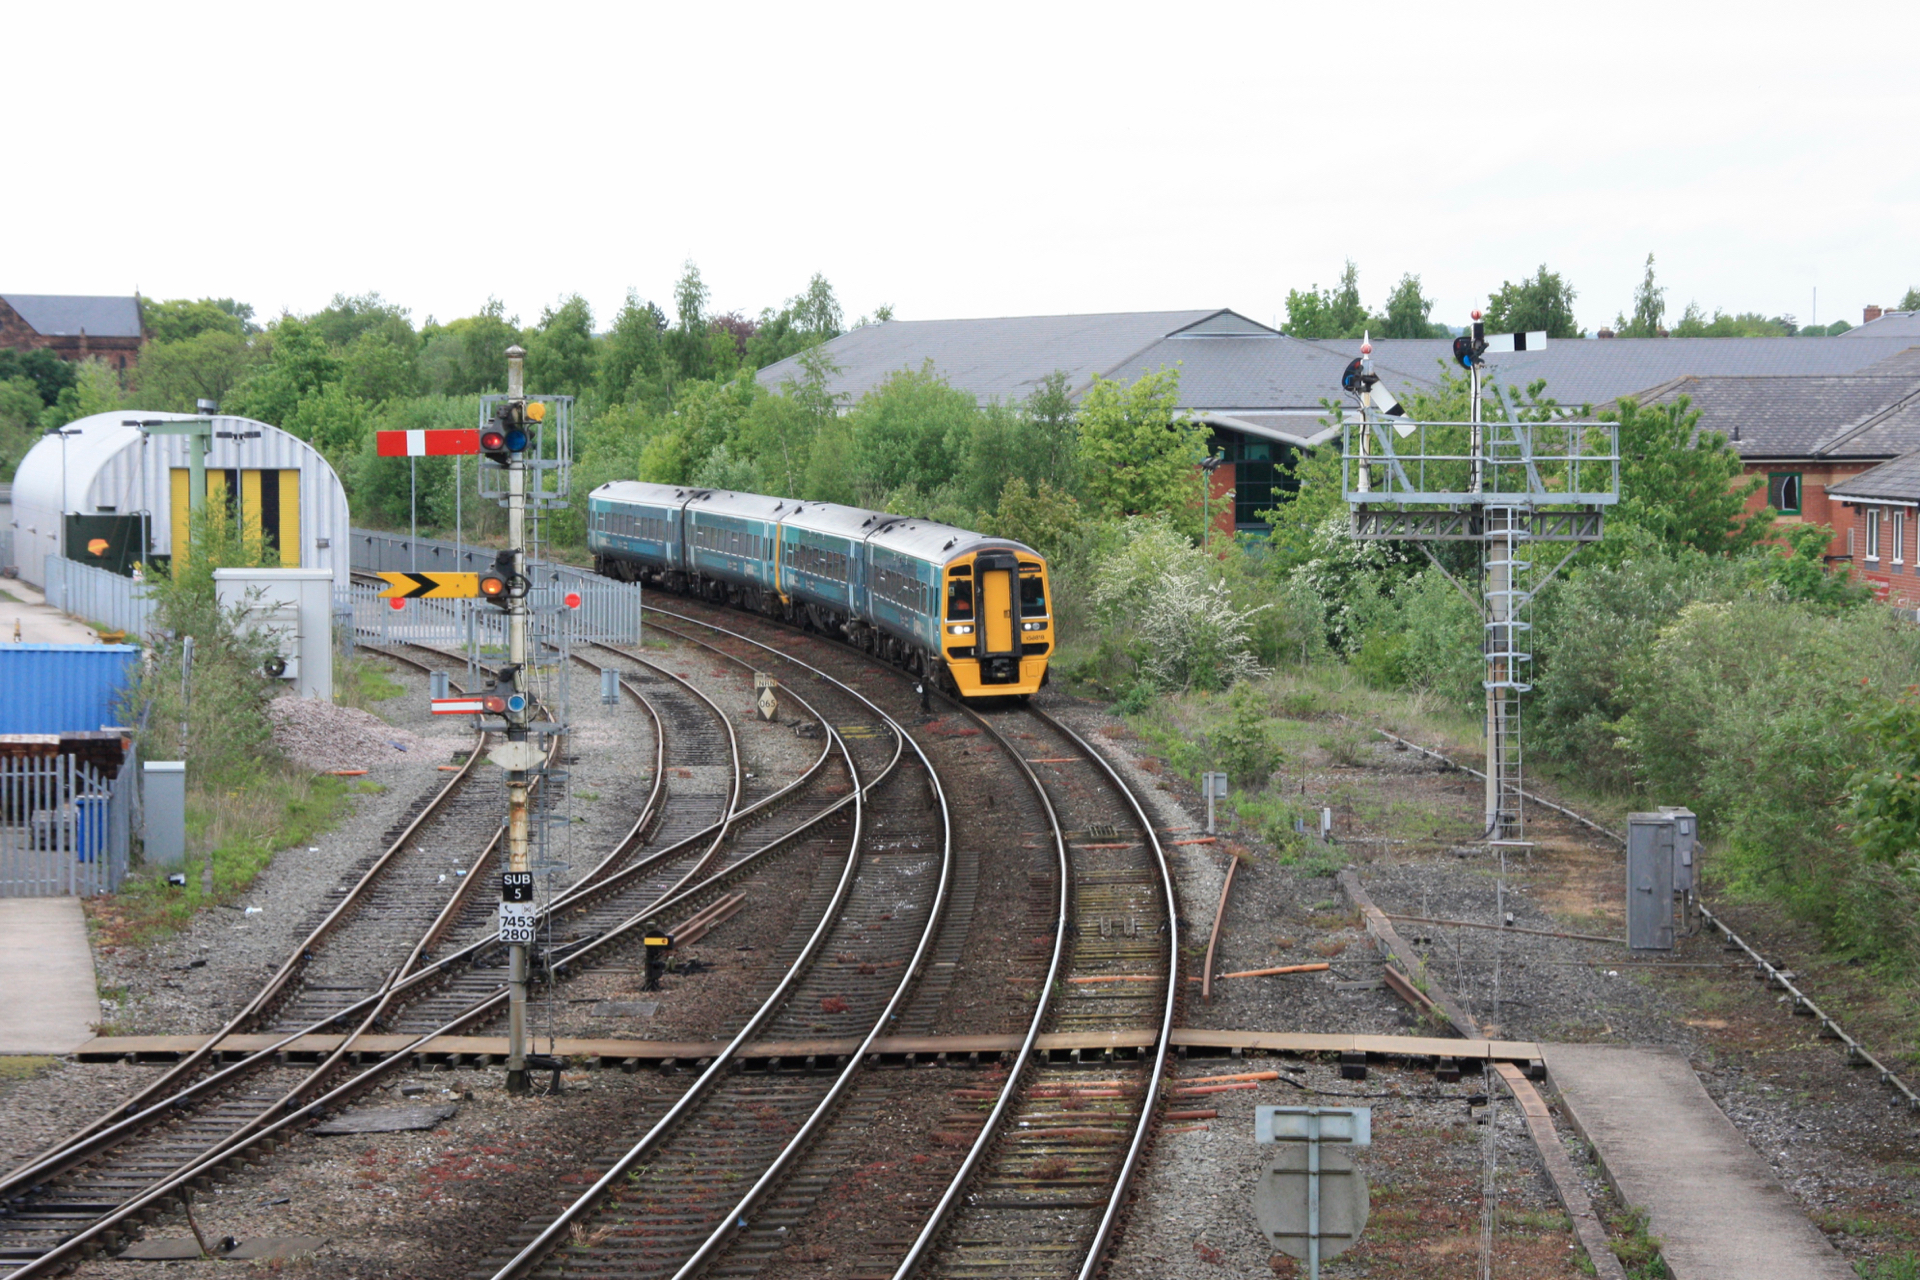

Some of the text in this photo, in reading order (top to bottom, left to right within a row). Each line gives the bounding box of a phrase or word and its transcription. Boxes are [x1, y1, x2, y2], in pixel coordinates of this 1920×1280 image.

[760, 700, 775, 708] 065
[504, 874, 530, 885] SUB
[514, 888, 521, 899] 5
[501, 916, 535, 927] 7453
[502, 929, 534, 940] 2801
